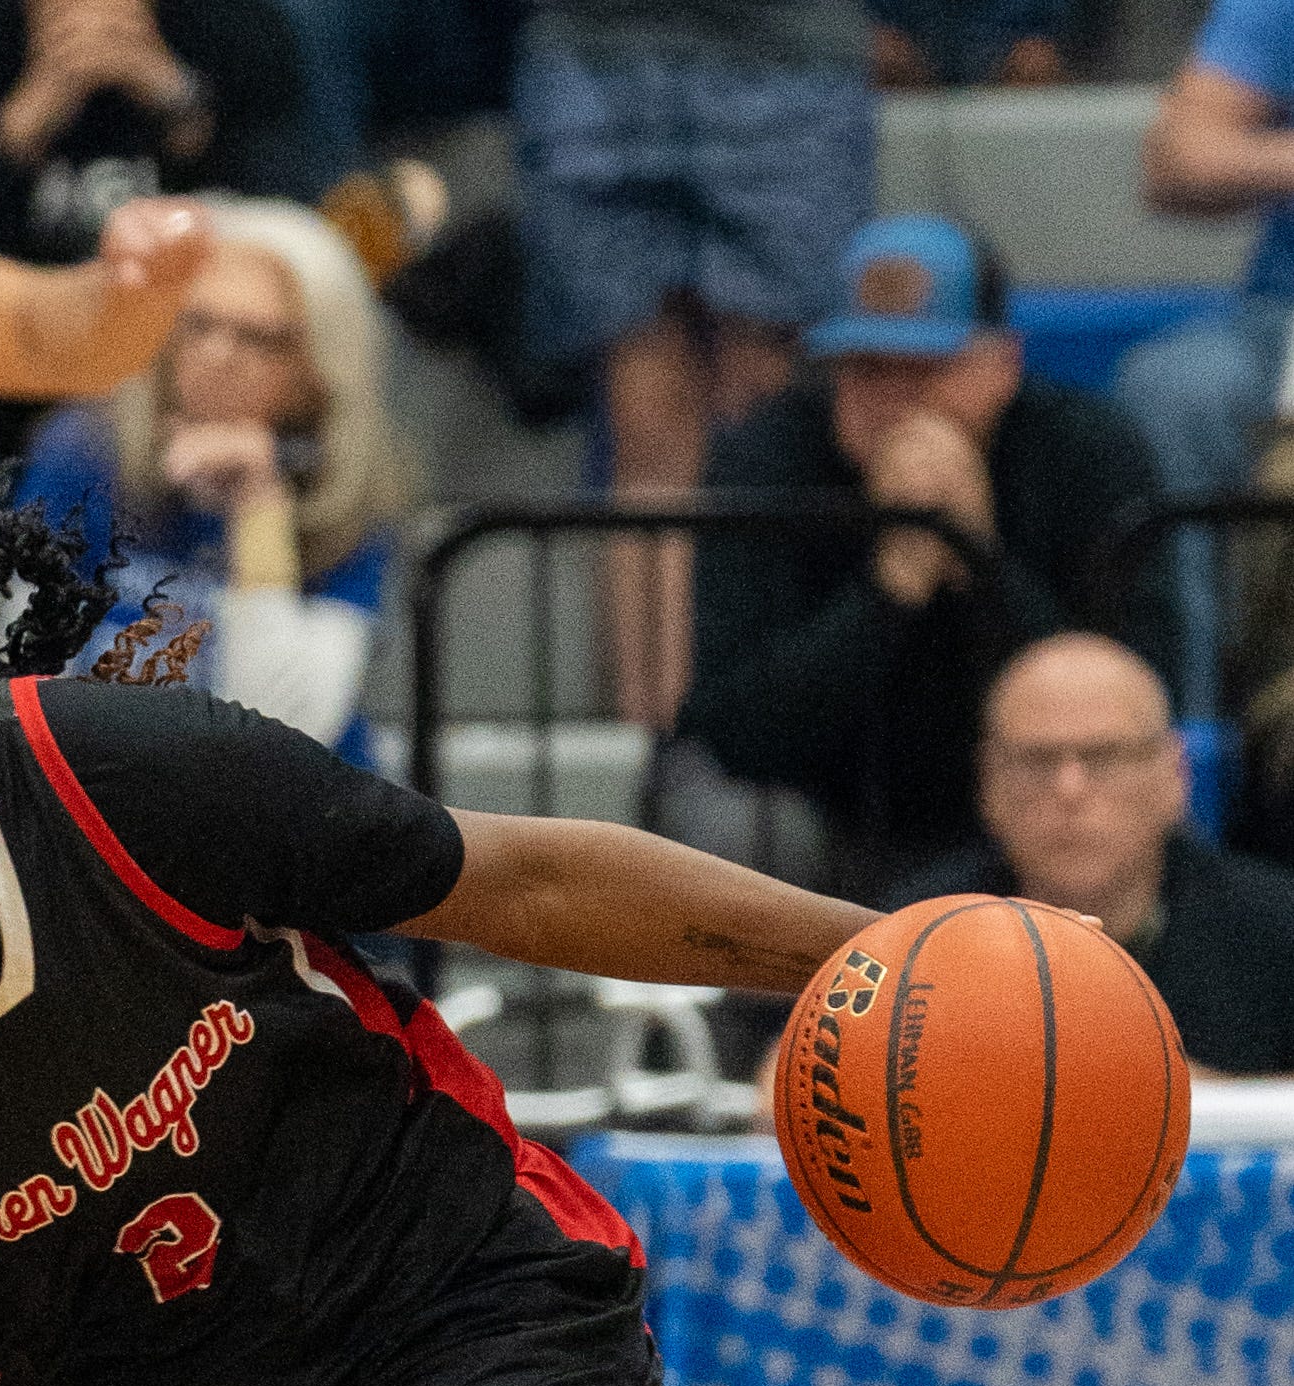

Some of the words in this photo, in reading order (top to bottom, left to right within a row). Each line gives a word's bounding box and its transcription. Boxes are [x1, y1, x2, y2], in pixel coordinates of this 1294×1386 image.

[50, 999, 255, 1191] Wagner
[812, 949, 887, 1213] Baden
[113, 1192, 222, 1303] 2
